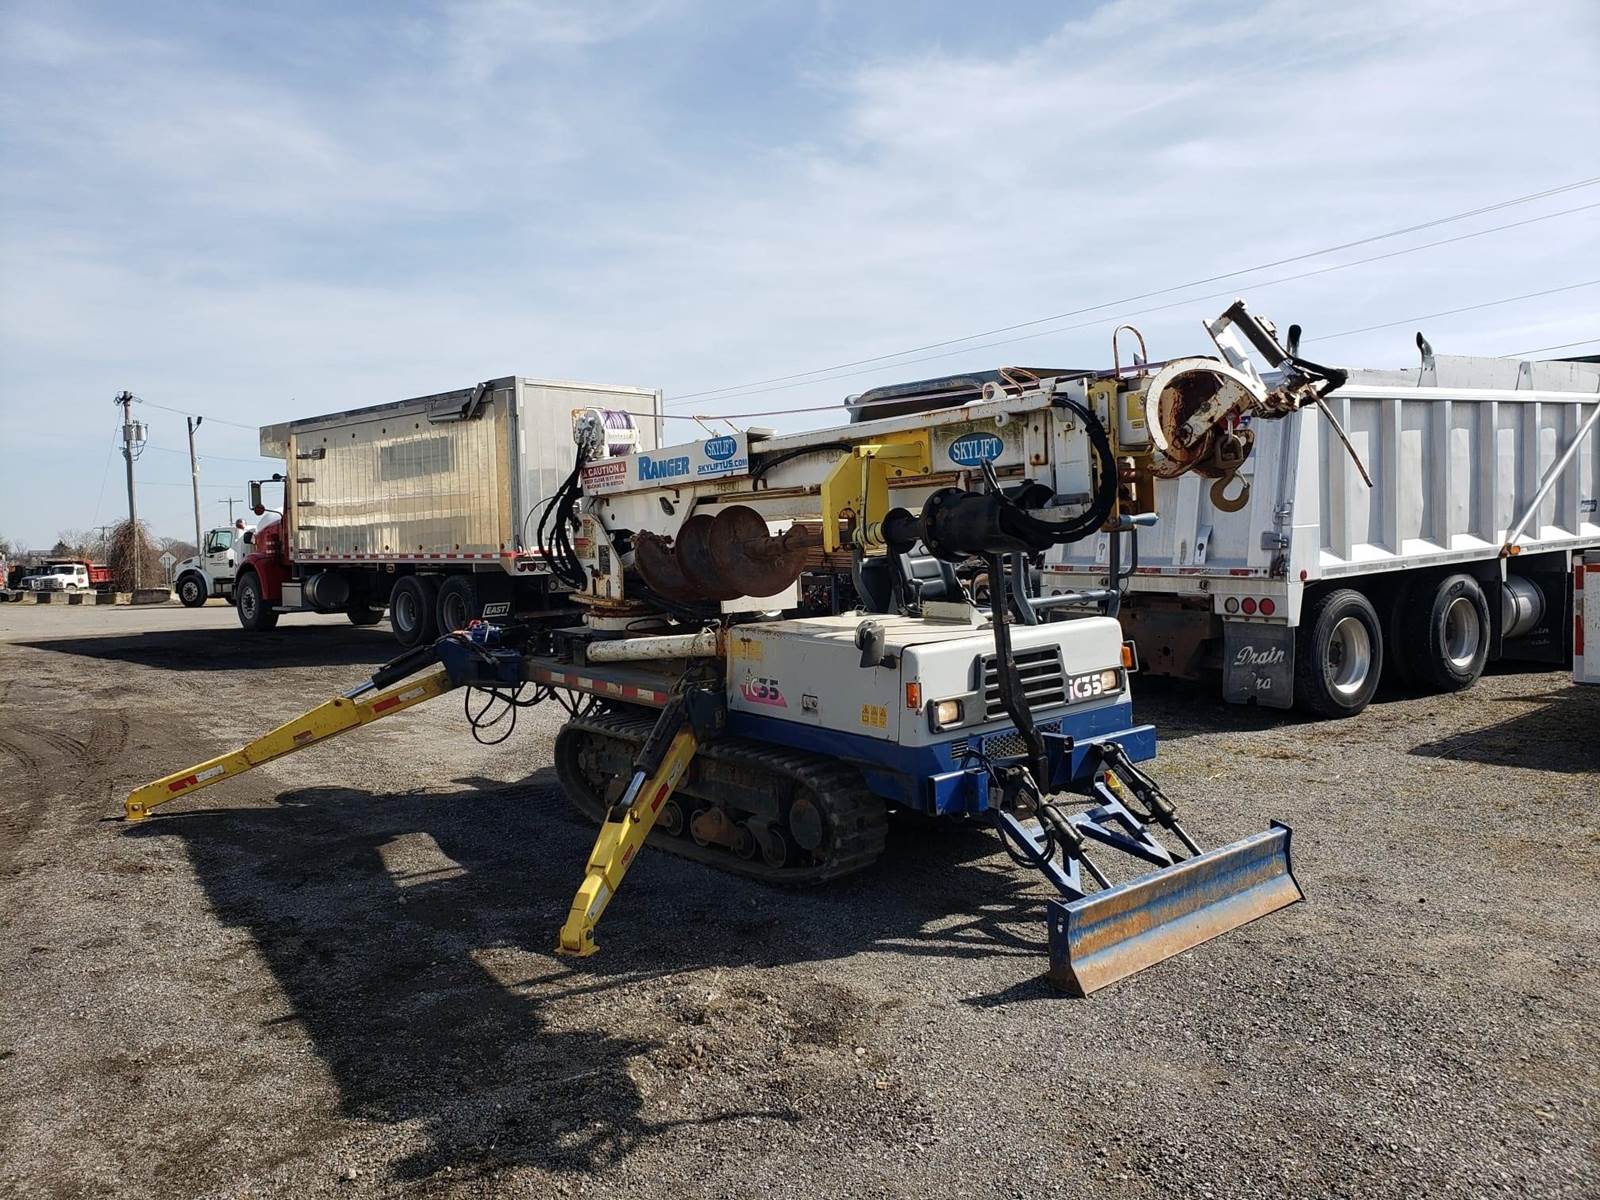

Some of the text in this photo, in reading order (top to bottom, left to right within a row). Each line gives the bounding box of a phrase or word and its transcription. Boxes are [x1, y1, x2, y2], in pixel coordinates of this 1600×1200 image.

[707, 439, 735, 456] SKYLIFT
[953, 438, 997, 461] SKYLIFT
[588, 464, 619, 477] CAUTION
[638, 455, 690, 481] RANGER
[697, 457, 748, 473] SKYLIFTUS.COM
[486, 606, 507, 615] EAST
[1233, 646, 1285, 665] Drain
